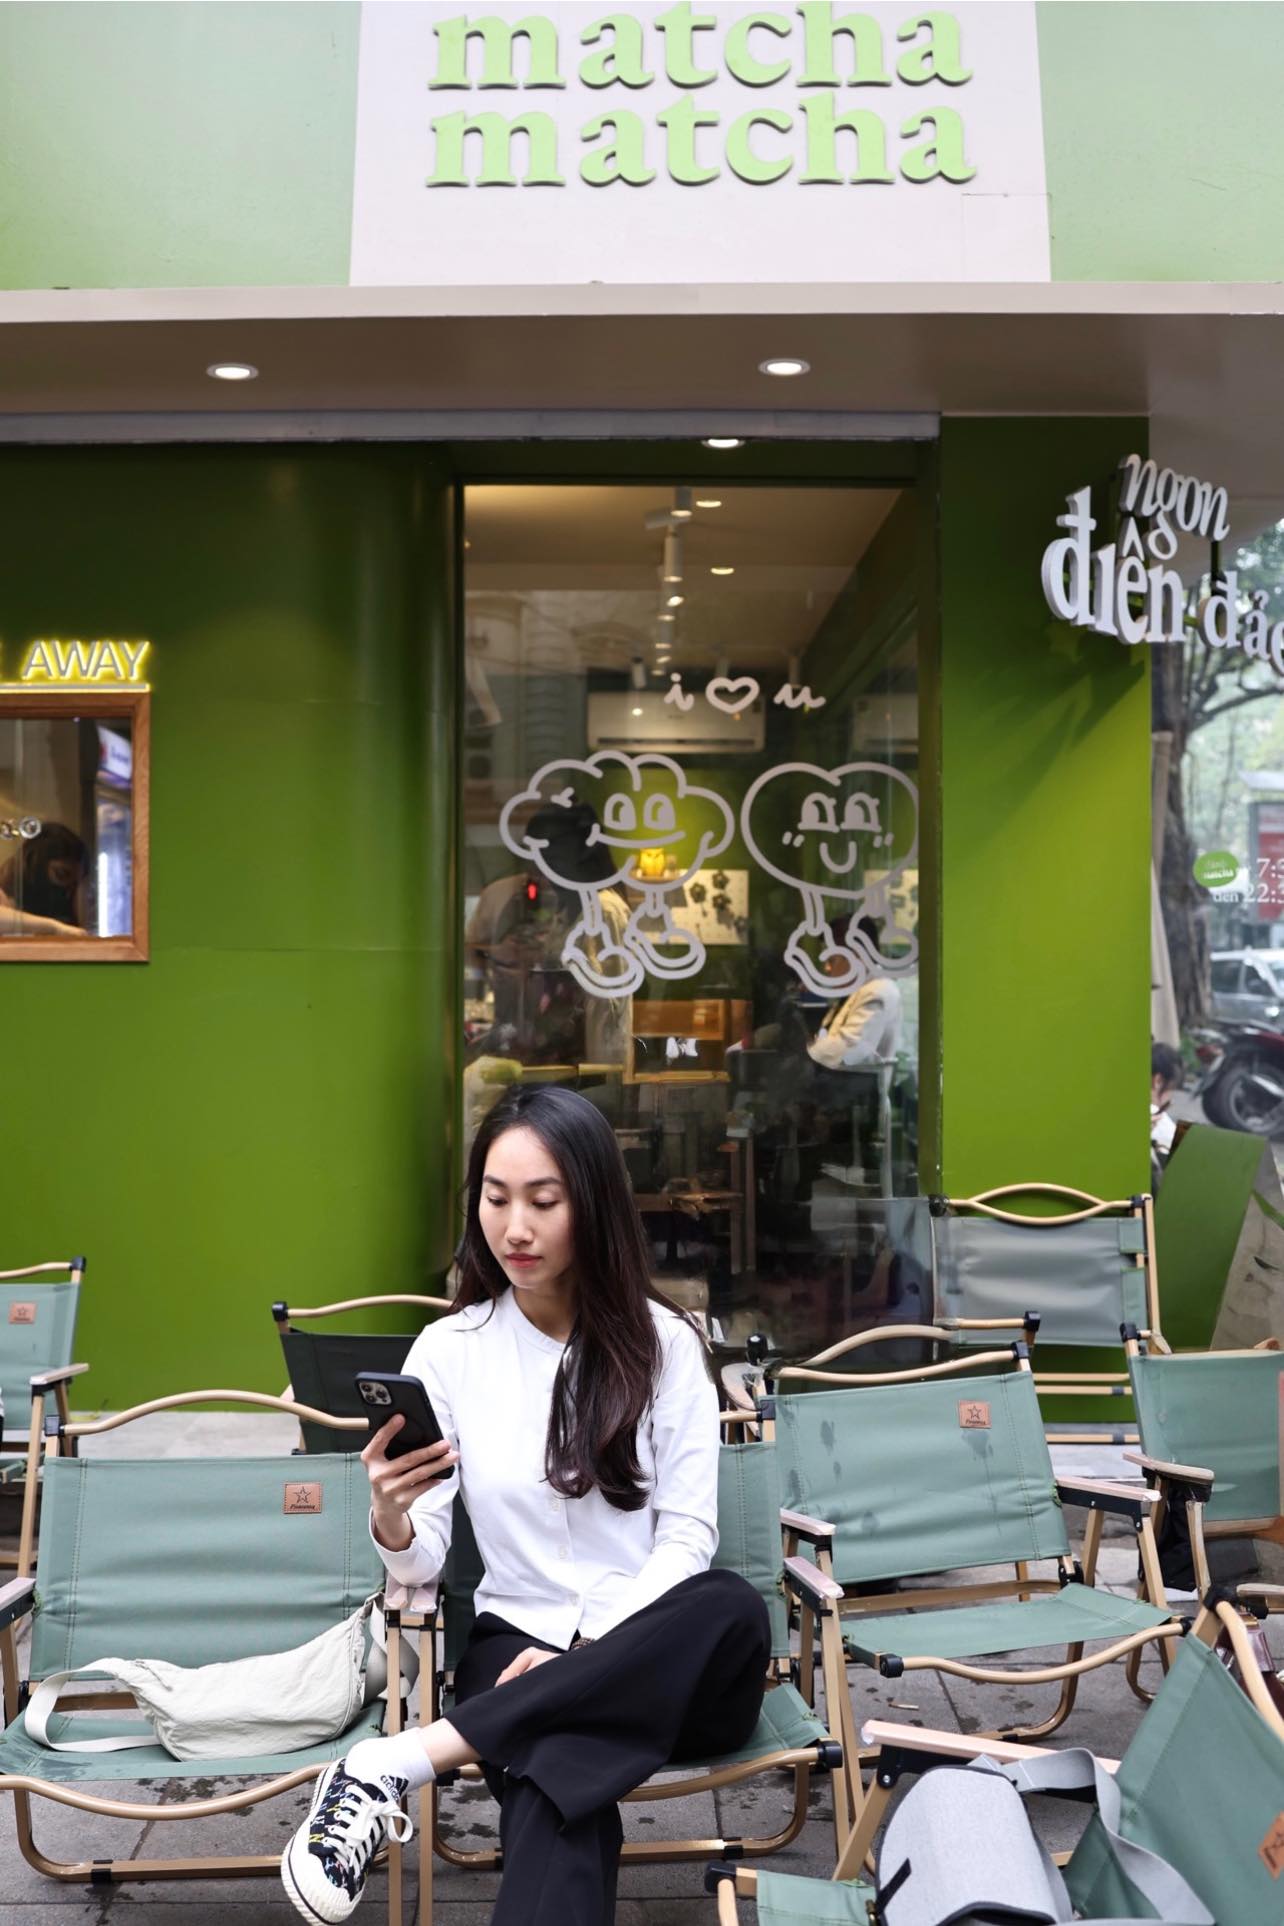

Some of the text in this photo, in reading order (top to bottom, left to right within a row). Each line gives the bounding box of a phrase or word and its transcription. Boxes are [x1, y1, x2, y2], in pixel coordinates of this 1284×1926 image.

[428, 0, 973, 89] matcha
[425, 91, 977, 187] matcha
[1118, 453, 1231, 560] ngon
[21, 639, 150, 681] AWAY
